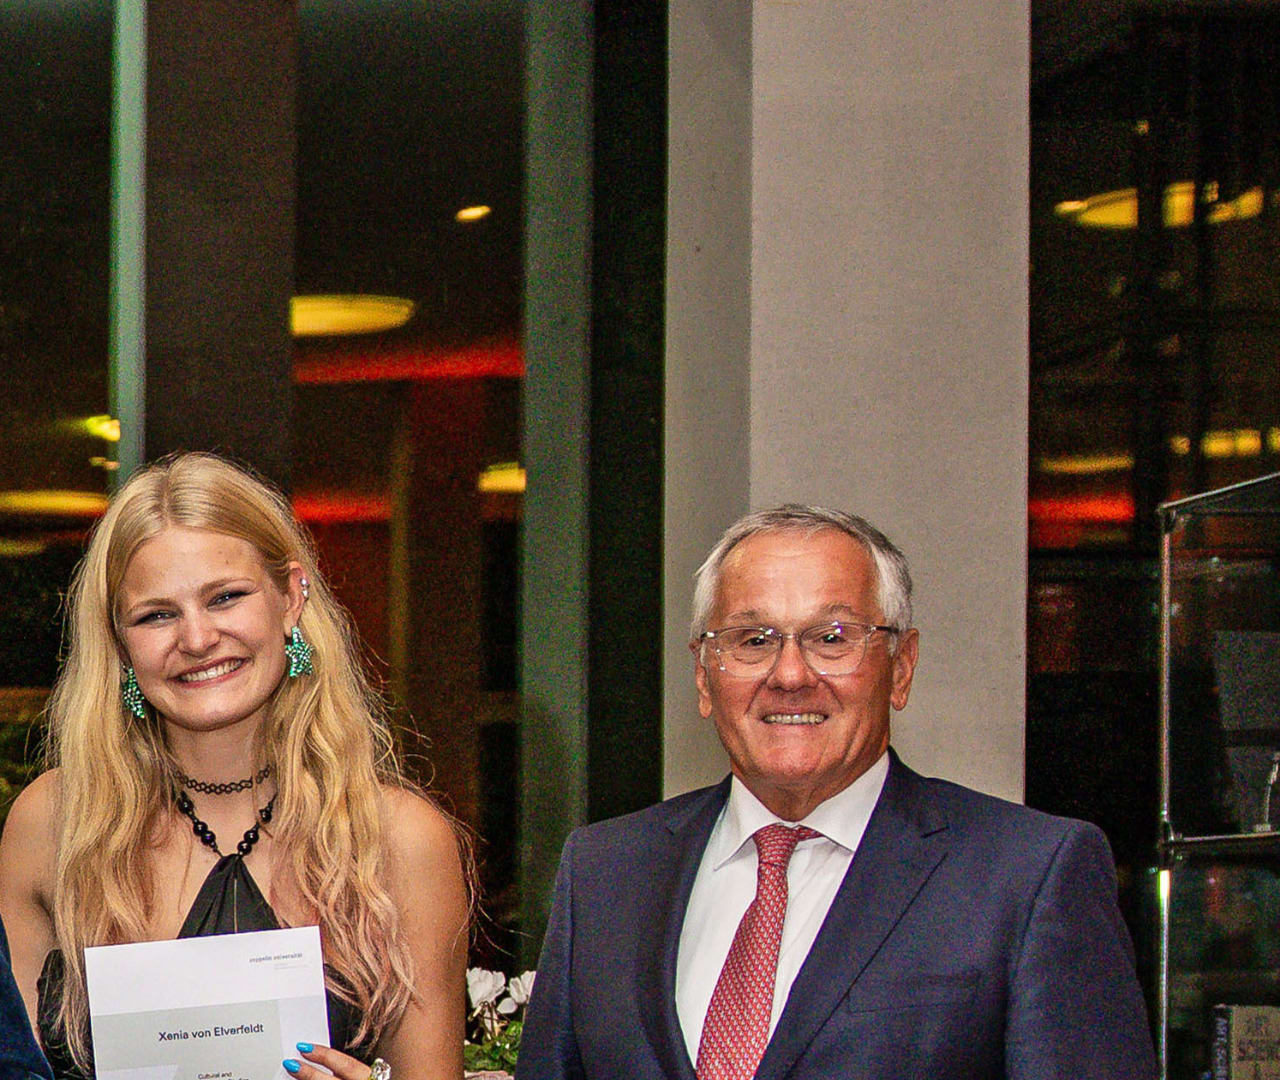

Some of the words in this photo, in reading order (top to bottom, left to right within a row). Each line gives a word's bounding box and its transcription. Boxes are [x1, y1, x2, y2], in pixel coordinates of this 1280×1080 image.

[158, 1030, 189, 1042] Xenia
[192, 1028, 211, 1038] von
[214, 1024, 264, 1037] Elverfeldt
